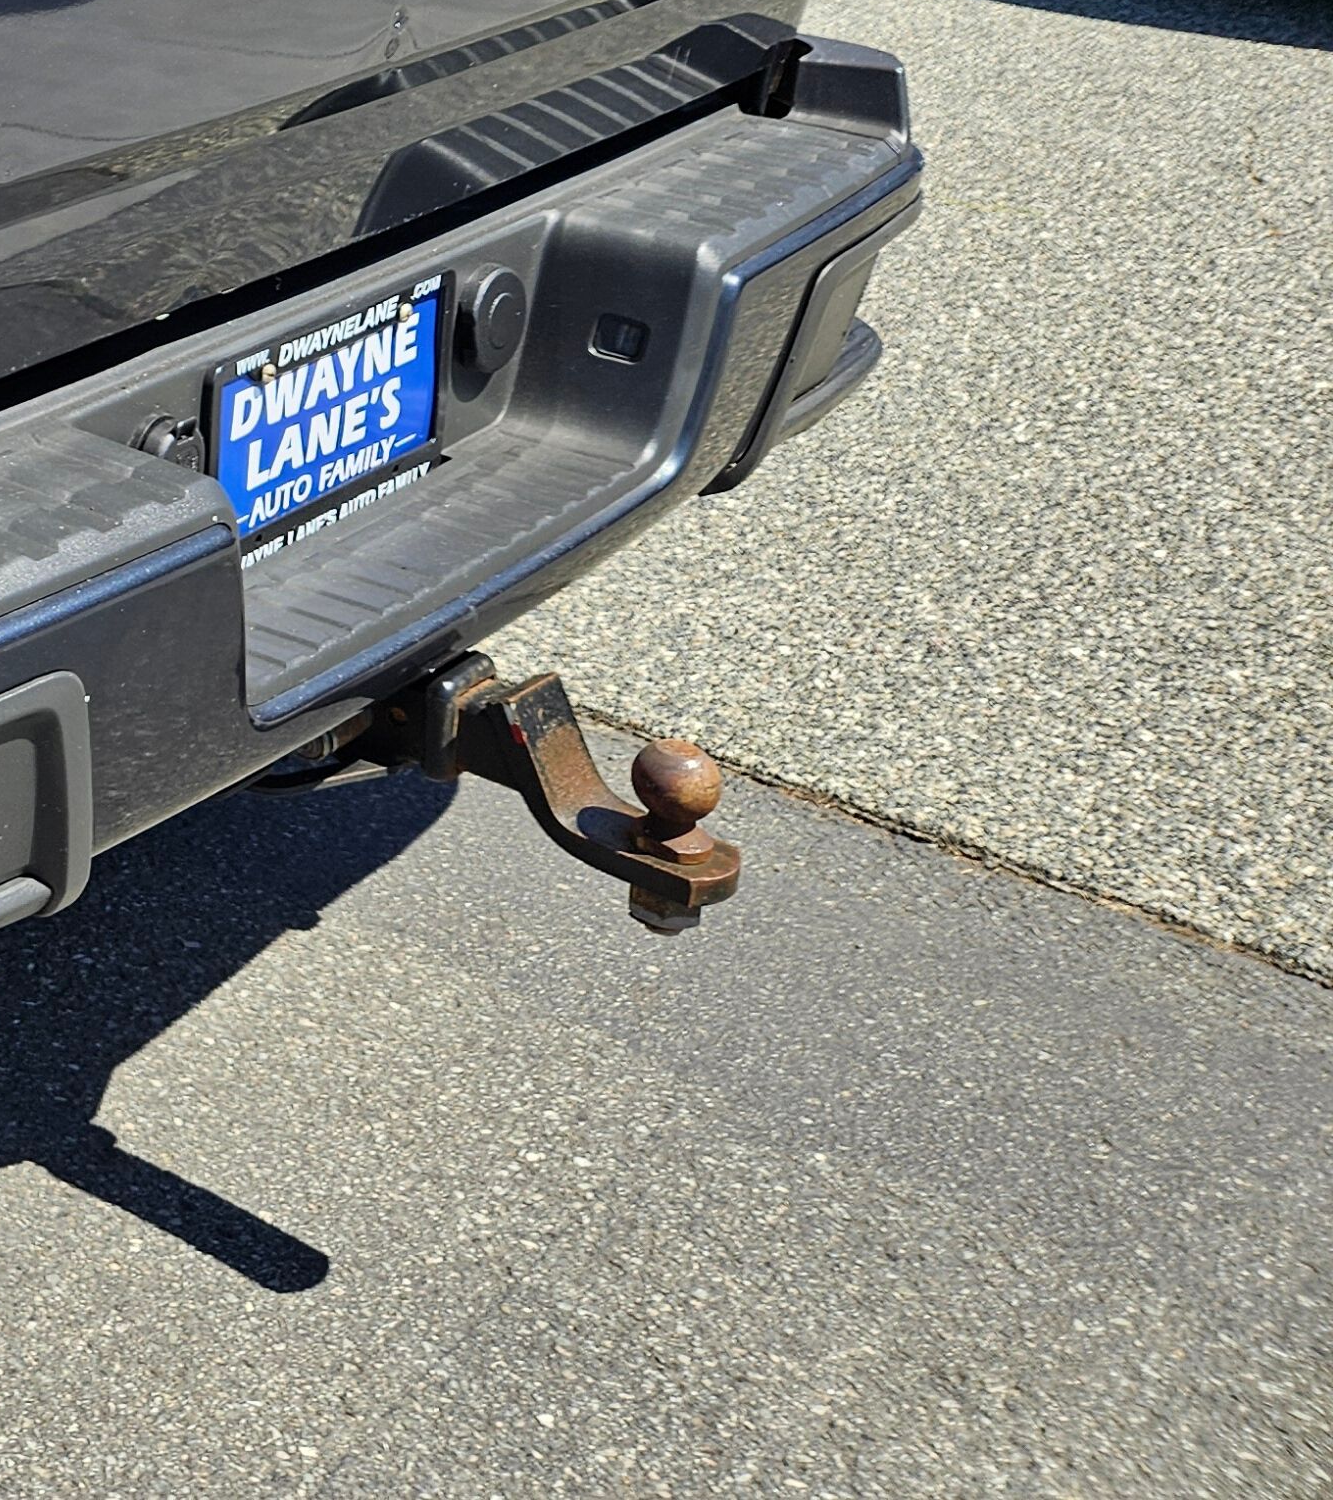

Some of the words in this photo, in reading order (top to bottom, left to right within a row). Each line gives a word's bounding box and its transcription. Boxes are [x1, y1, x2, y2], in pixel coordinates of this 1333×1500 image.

[231, 312, 420, 441] DWAYNE
[277, 295, 400, 367] DWAYNELANE
[246, 377, 401, 491] LANE'S
[248, 474, 312, 528] AUTO
[318, 436, 396, 491] FAMILY
